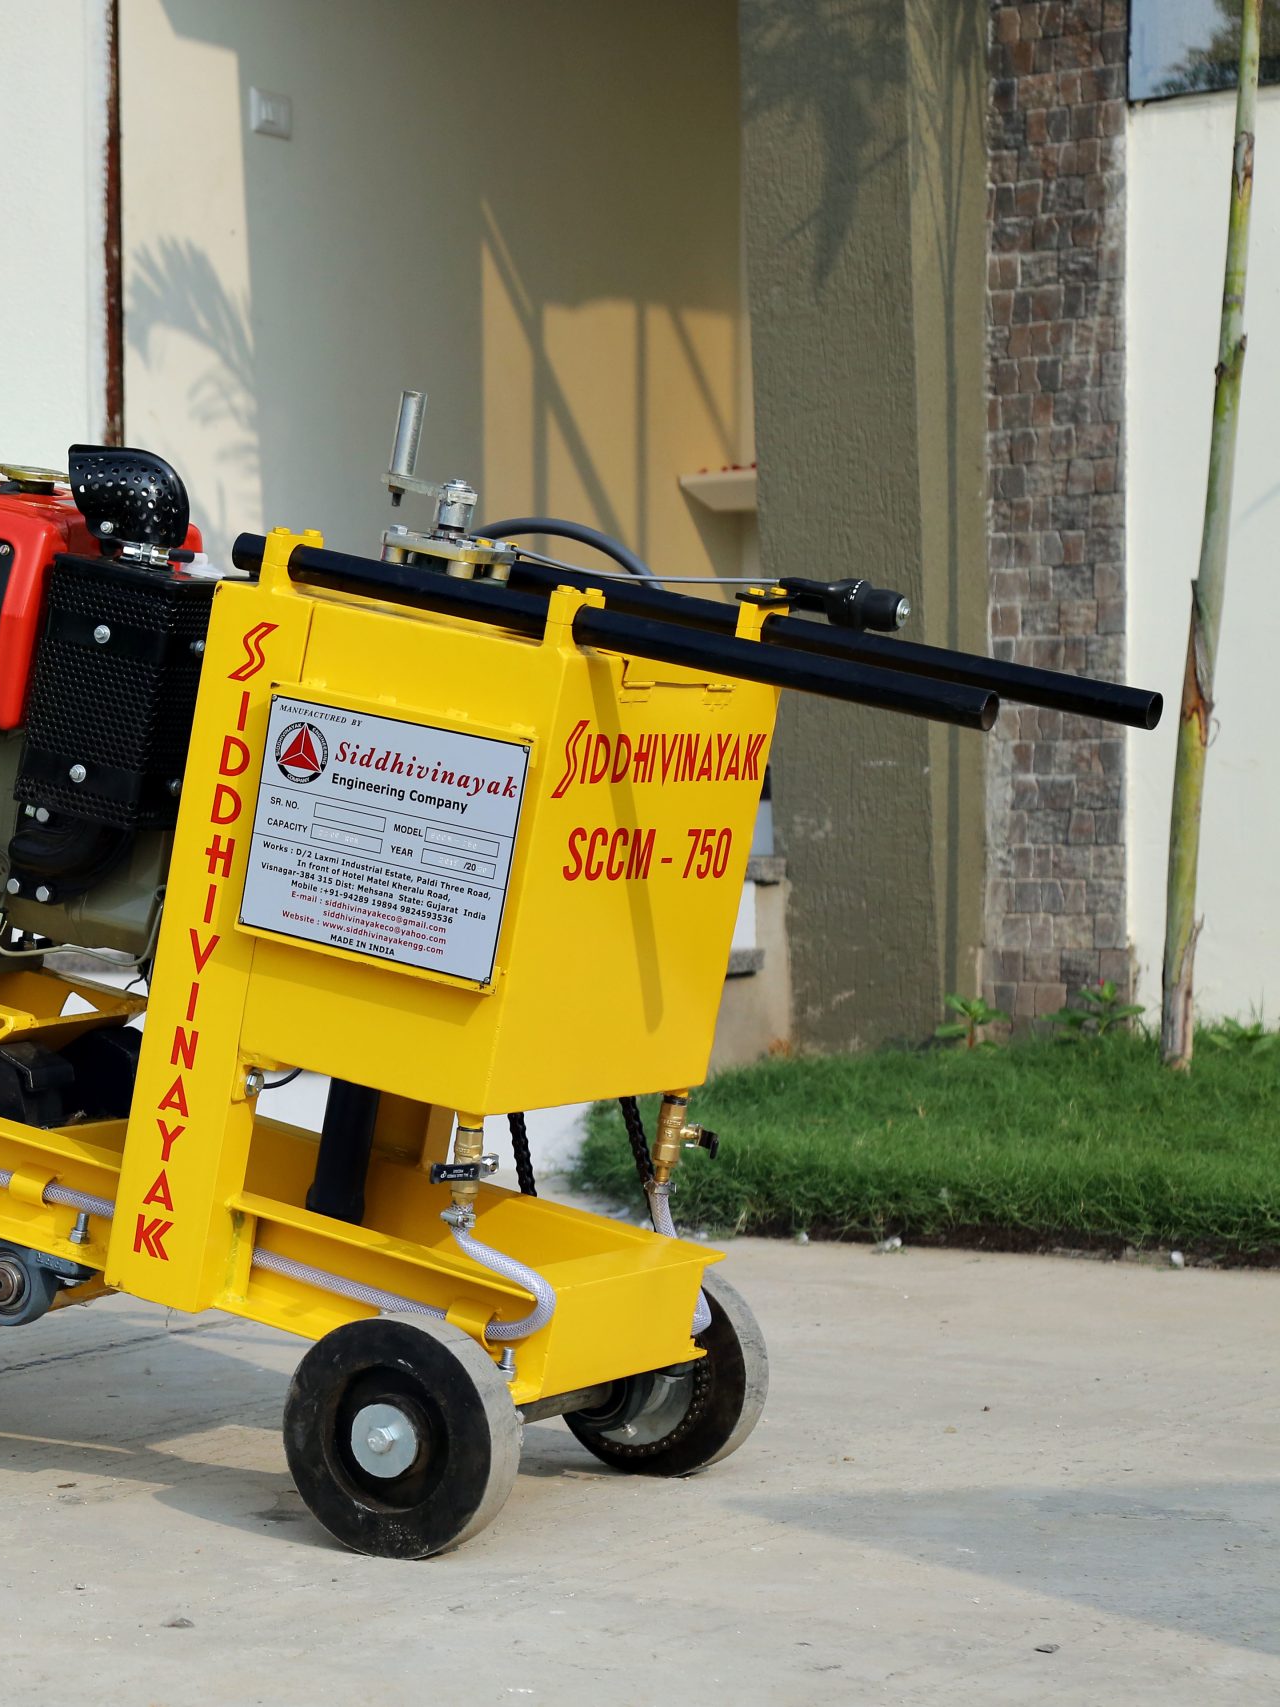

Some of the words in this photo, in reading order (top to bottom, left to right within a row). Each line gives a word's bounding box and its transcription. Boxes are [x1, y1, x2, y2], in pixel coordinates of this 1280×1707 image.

[279, 704, 347, 724] MANUFACTURED
[351, 719, 363, 727] BY
[275, 722, 302, 756] SIDDHIVINAYAK
[312, 727, 328, 765] ENGINEERING
[550, 720, 767, 798] SIDDHIVINAYAK
[286, 773, 310, 783] COMPANY
[335, 741, 518, 798] Siddhivinayak
[270, 796, 283, 806] SR.
[285, 799, 299, 810] NO.
[331, 773, 406, 801] Engineering
[409, 789, 468, 814] Company
[267, 817, 308, 833] CAPACITY
[393, 823, 424, 838] MODEL
[263, 840, 288, 853] Works
[296, 848, 312, 859] D/2
[314, 852, 339, 865] Laxmi
[341, 859, 382, 875] Industrial
[384, 868, 414, 883] Estate,
[416, 876, 438, 888] Paldi
[440, 881, 464, 893] Three
[467, 888, 491, 901] Road,
[390, 845, 413, 858] YEAR
[562, 827, 656, 881] SCCM
[682, 828, 732, 880] 750
[261, 862, 315, 880] Visnagar-384
[317, 874, 333, 885] 315
[335, 879, 355, 890] Dist:
[357, 884, 394, 899] Mehsana
[398, 894, 424, 906] State:
[426, 900, 459, 914] Gujarat
[463, 908, 486, 921] India
[290, 879, 318, 892] Mobile
[371, 898, 398, 911] 19894
[400, 905, 453, 924] 9824593536
[297, 859, 306, 868] In
[308, 861, 329, 873] front
[331, 867, 340, 876] of
[342, 869, 365, 881] Hotel
[366, 875, 390, 887] Matel
[391, 882, 424, 895] Kheralu
[427, 889, 451, 903] Road,
[282, 909, 315, 924] Website
[322, 920, 444, 955] www.siddhivinayakengg.com
[291, 891, 317, 903] E-mail
[324, 899, 447, 934] siddhivinayakeco@gmail.com
[322, 909, 447, 945] siddhivinayakeco@yahoo.com
[132, 623, 280, 1263] SIDDHIVINAYAK
[330, 934, 354, 946] MADE
[356, 940, 367, 949] IN
[368, 943, 395, 956] INDIA
